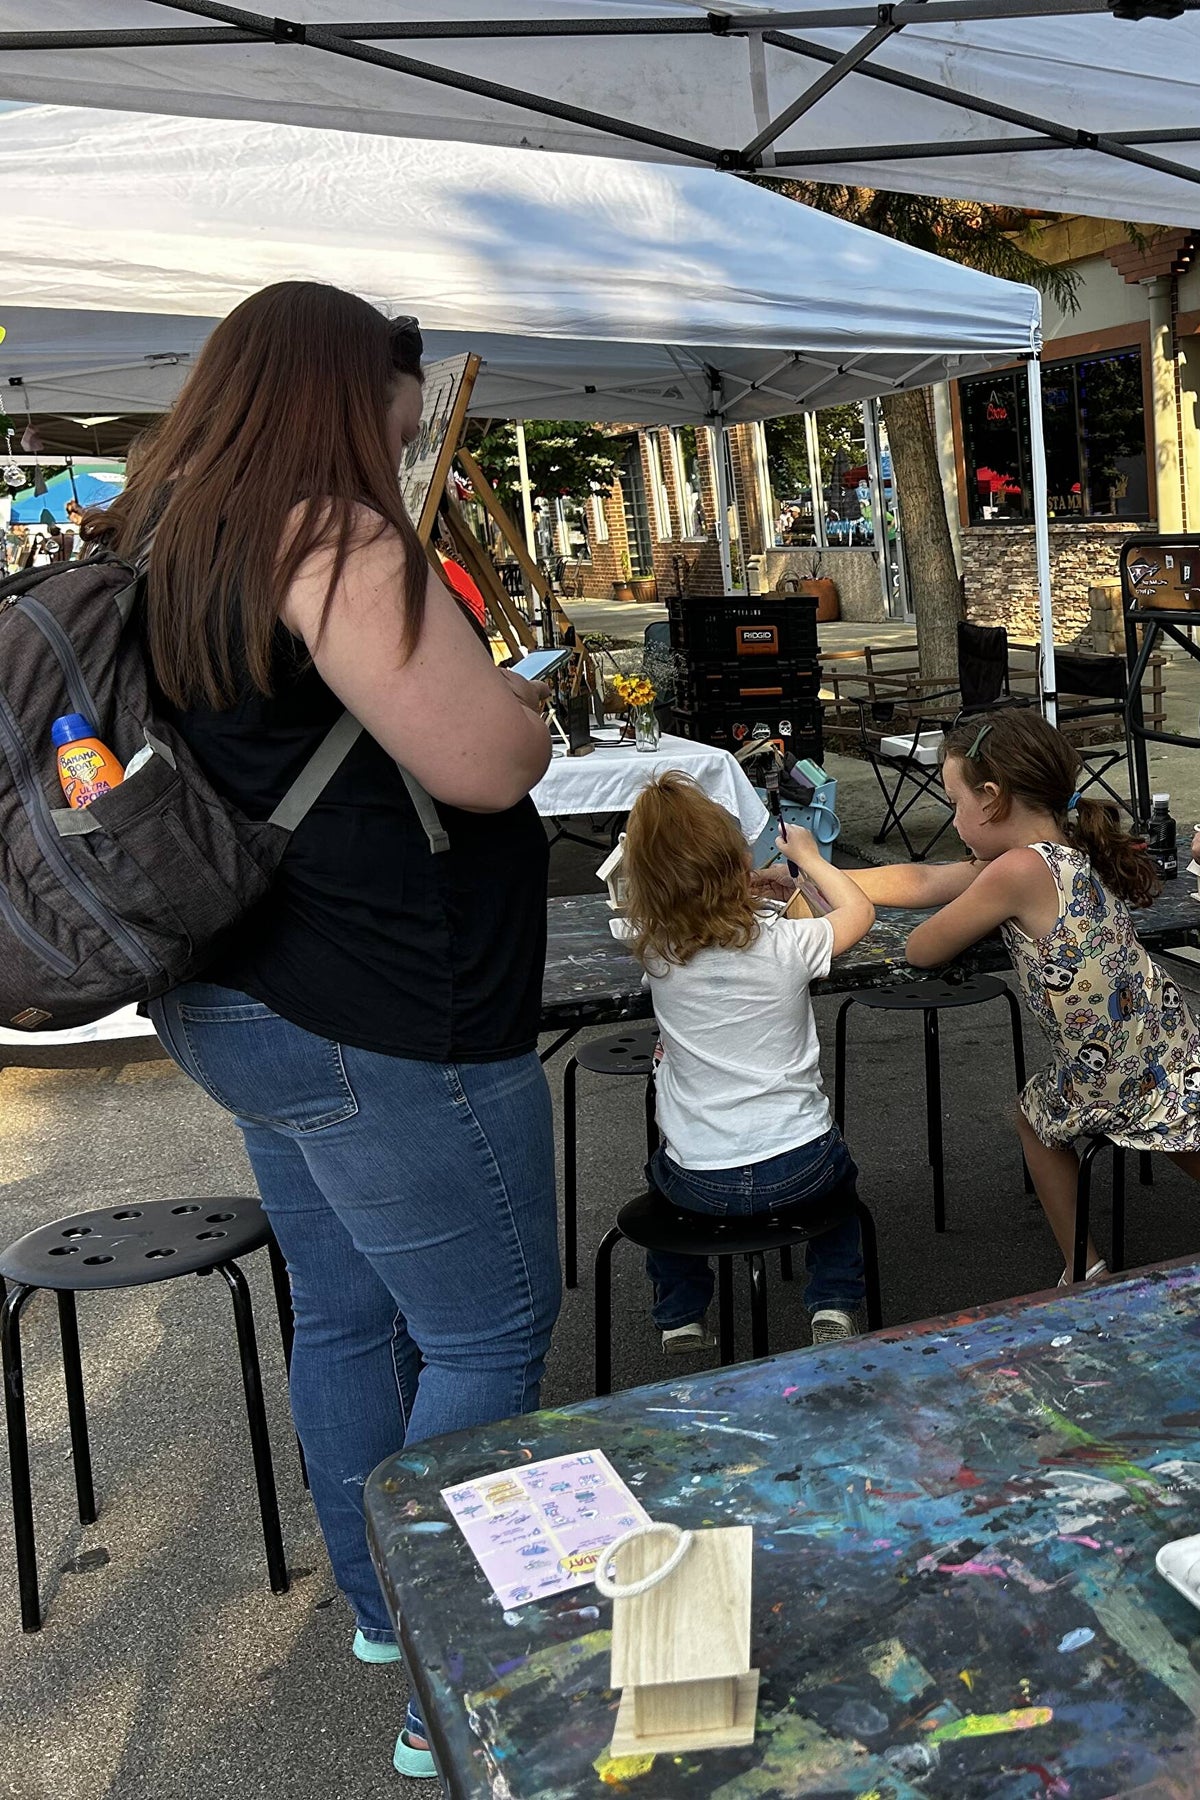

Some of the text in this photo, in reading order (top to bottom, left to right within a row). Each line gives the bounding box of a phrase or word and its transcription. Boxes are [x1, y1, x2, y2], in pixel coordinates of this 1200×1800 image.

[743, 631, 772, 641] RIDGID
[60, 751, 97, 769] BANANA
[67, 760, 94, 777] BOAT
